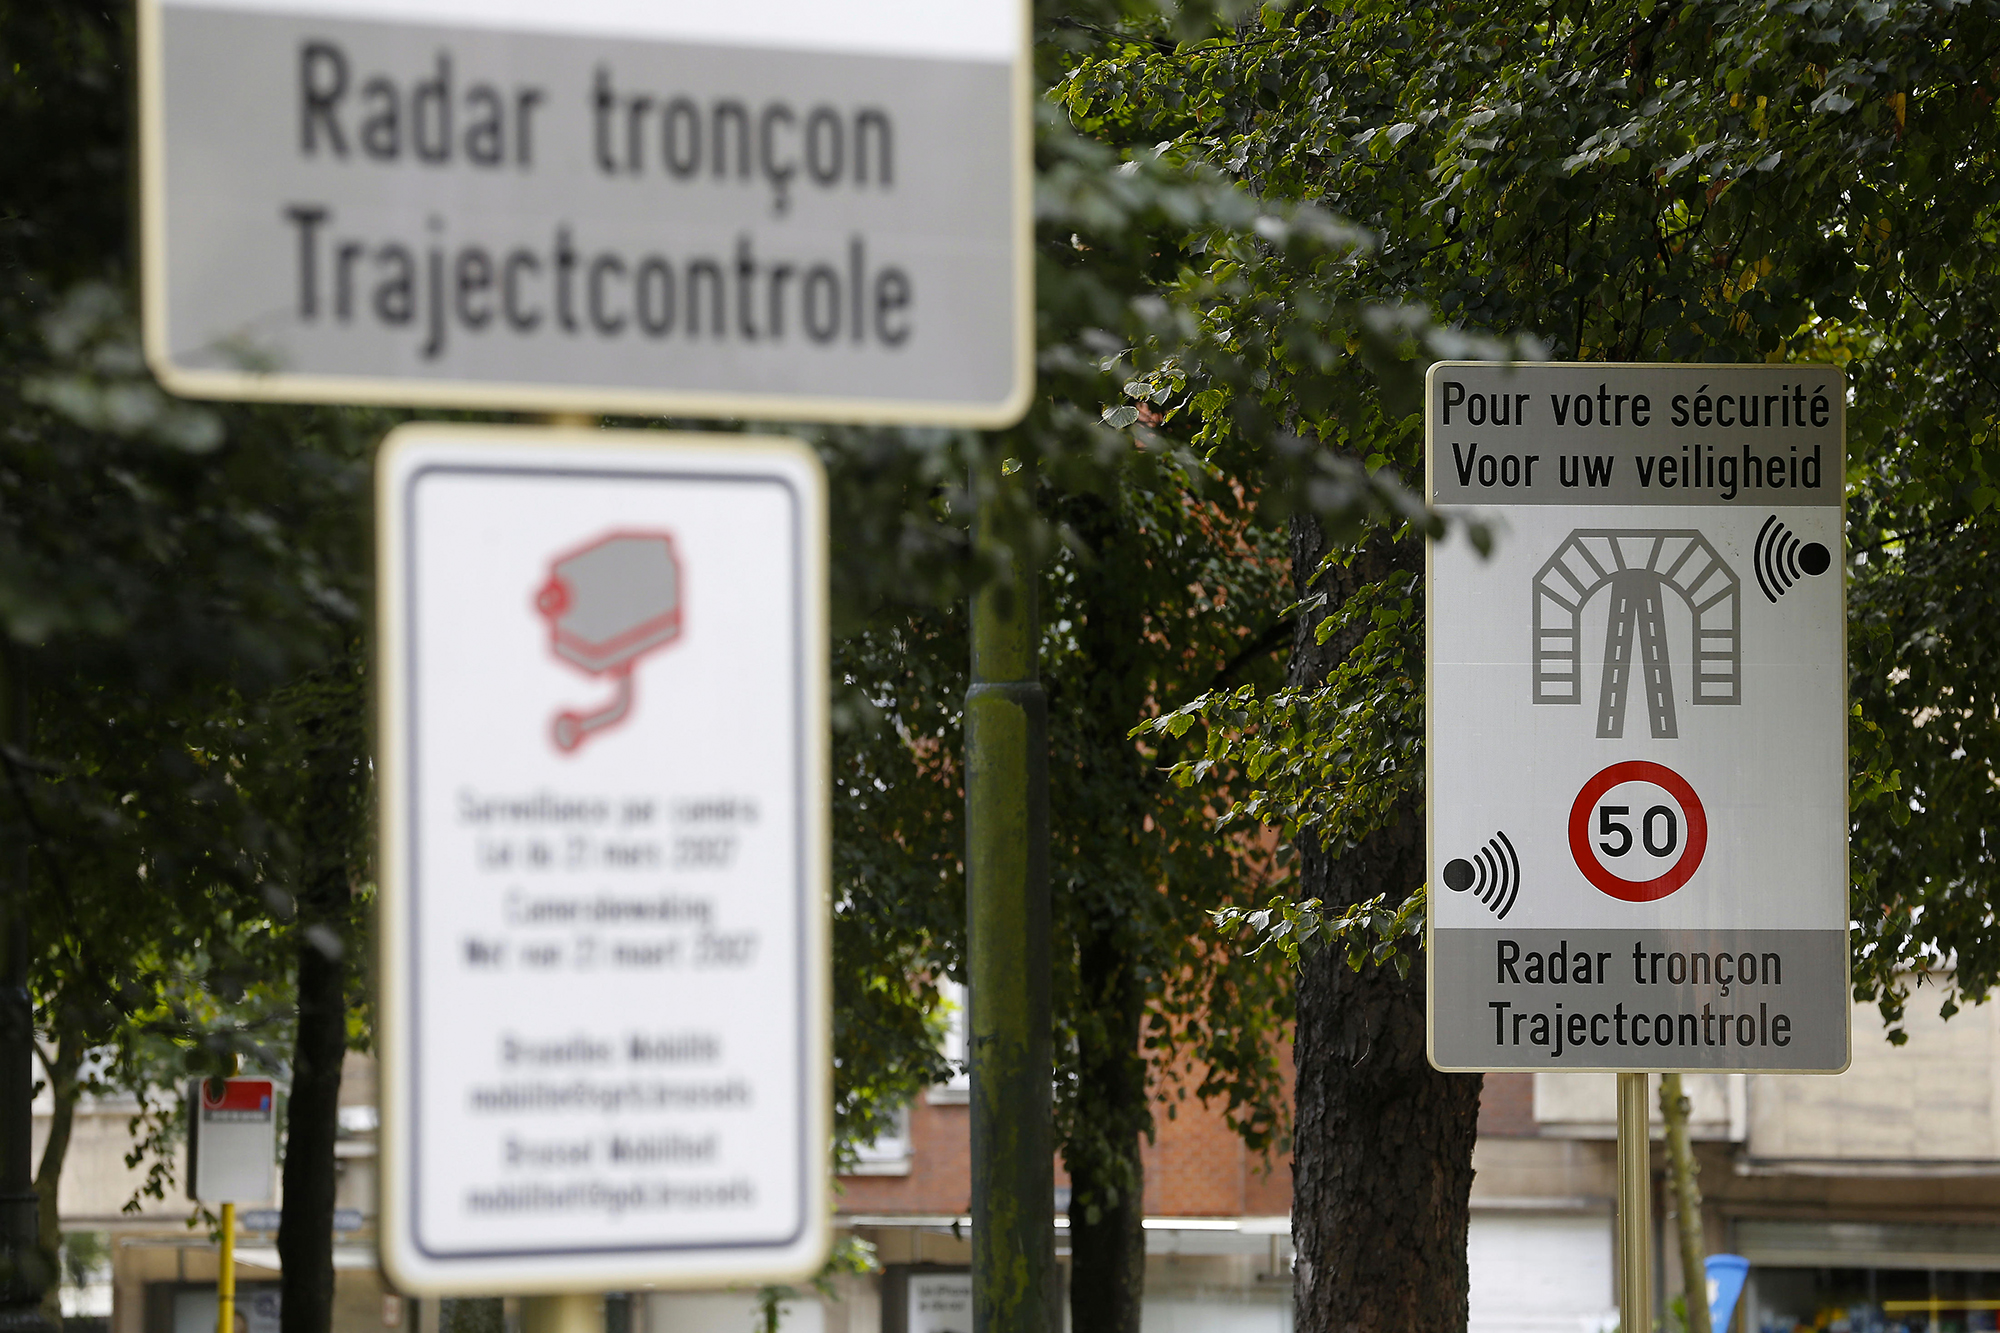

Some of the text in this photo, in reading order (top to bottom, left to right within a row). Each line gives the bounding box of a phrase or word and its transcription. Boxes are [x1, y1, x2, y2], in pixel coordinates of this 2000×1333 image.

[296, 38, 896, 217] Radar tronçon
[283, 205, 915, 362] Trajectcontrole
[1442, 381, 1830, 428] Pour votre sécurité
[1451, 442, 1821, 501] Voor uw veiligheid
[1598, 804, 1678, 858] 50
[1497, 939, 1782, 998] Radar tronçon
[1488, 1001, 1792, 1058] Trajectcontrole
